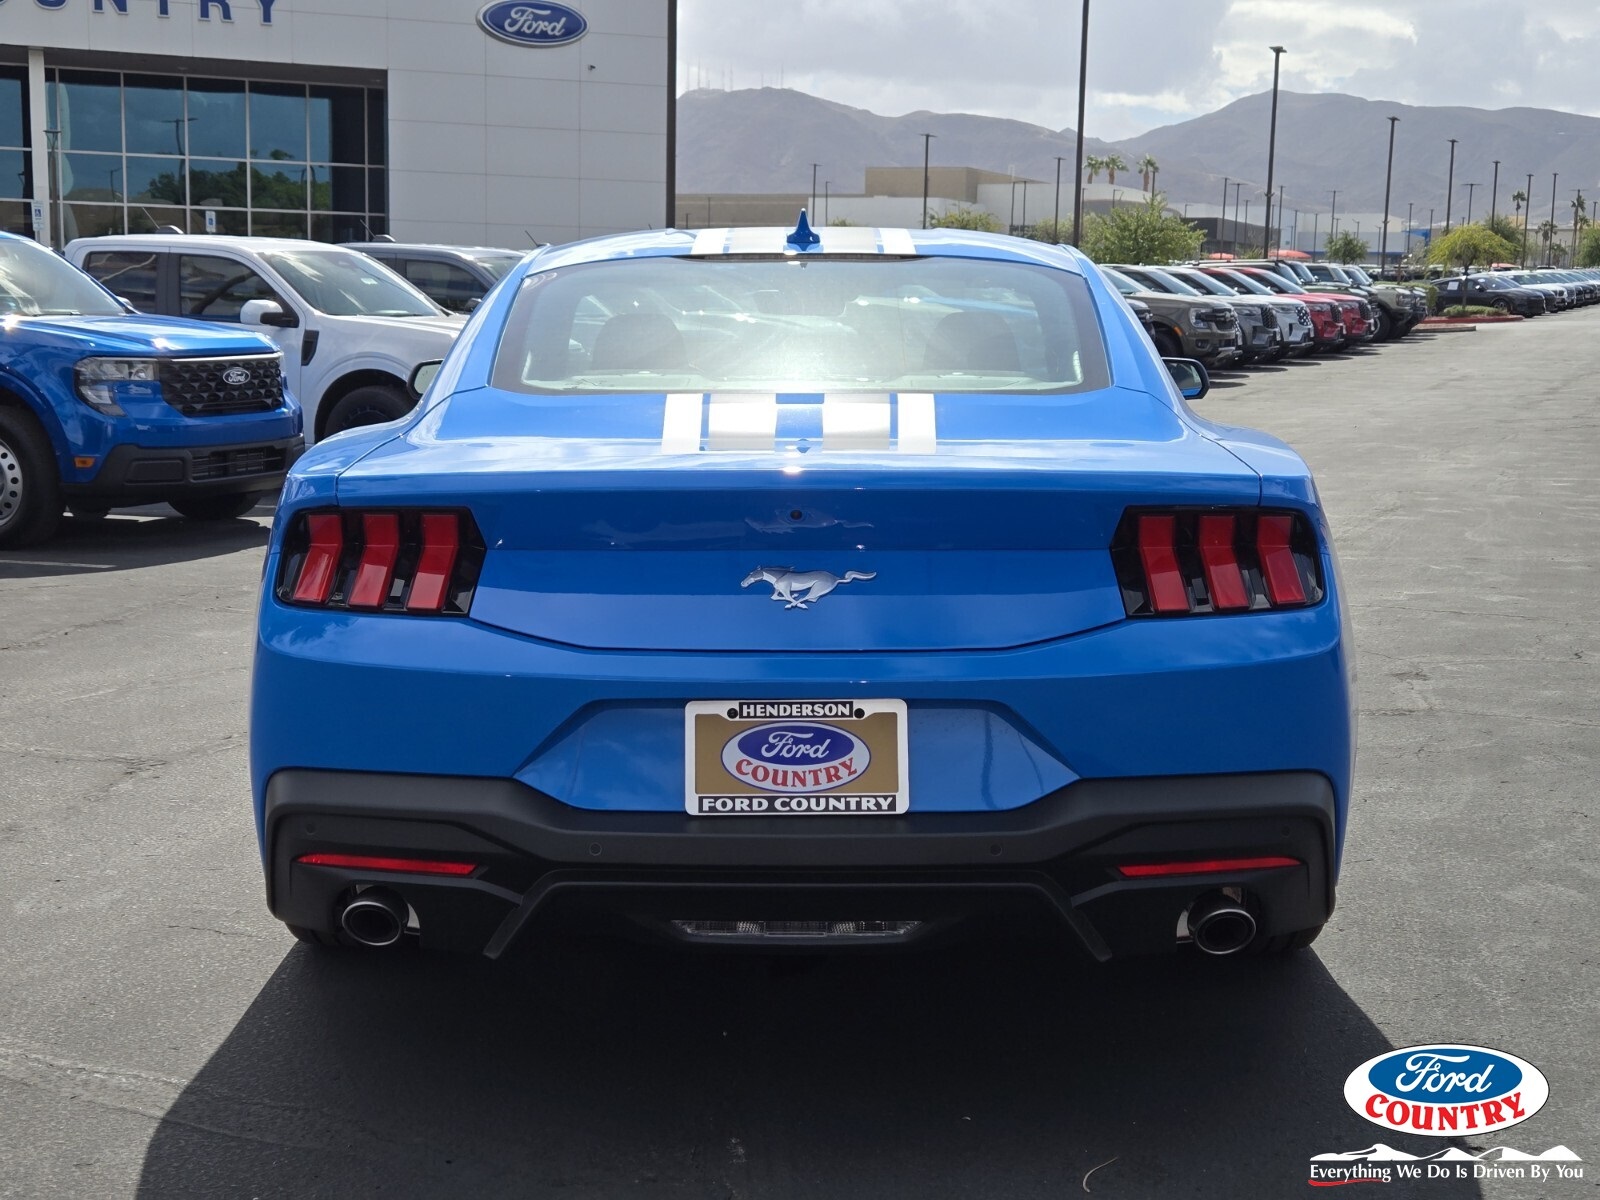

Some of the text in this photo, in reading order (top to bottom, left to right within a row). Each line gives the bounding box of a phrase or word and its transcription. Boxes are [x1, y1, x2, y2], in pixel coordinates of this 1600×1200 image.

[504, 6, 567, 36] Ford
[228, 371, 246, 382] Ford
[742, 703, 850, 717] HENDERSON
[761, 731, 831, 758] Ford
[735, 758, 857, 787] COUNTRY
[702, 796, 893, 812] FORD COUNTRY
